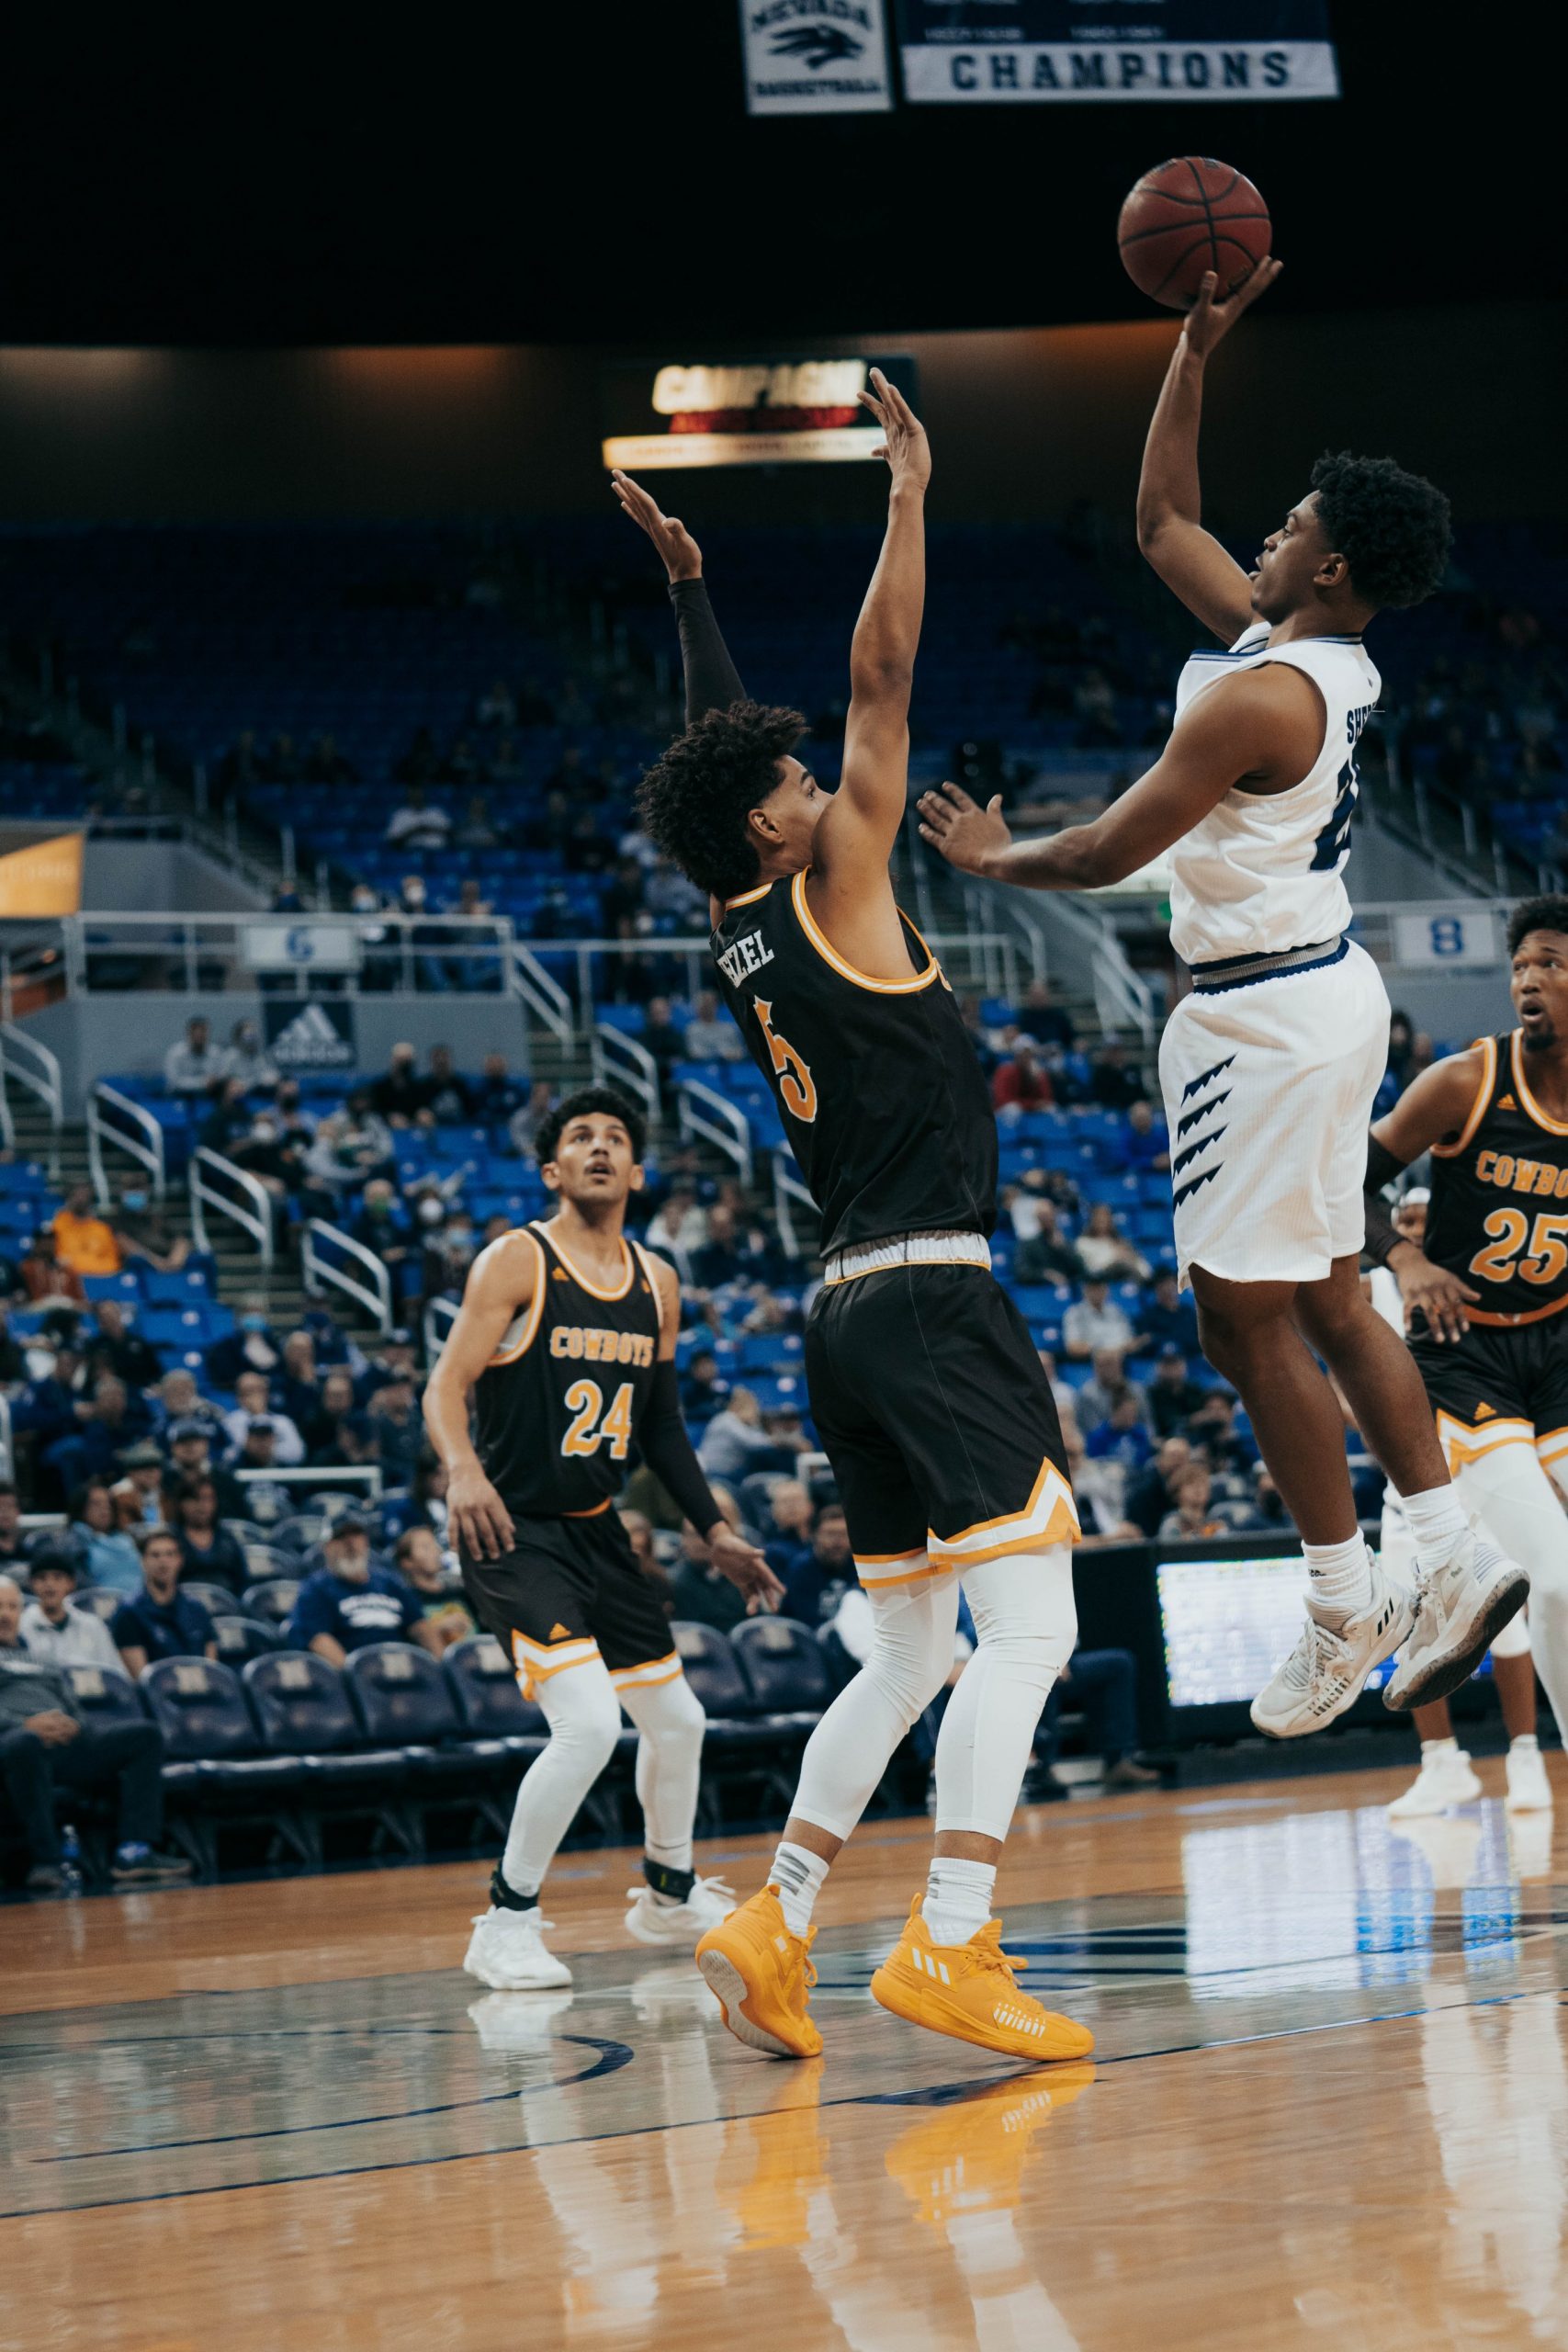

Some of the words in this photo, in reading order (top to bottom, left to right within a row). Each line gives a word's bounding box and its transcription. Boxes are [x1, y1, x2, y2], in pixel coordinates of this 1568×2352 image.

[951, 51, 1291, 90] CHAMPIONS
[1430, 915, 1463, 957] 8
[753, 995, 818, 1123] 5
[1476, 1150, 1568, 1198] COWBO
[1469, 1207, 1568, 1284] 25
[549, 1326, 655, 1368] COWBOYS
[561, 1379, 634, 1460] 24
